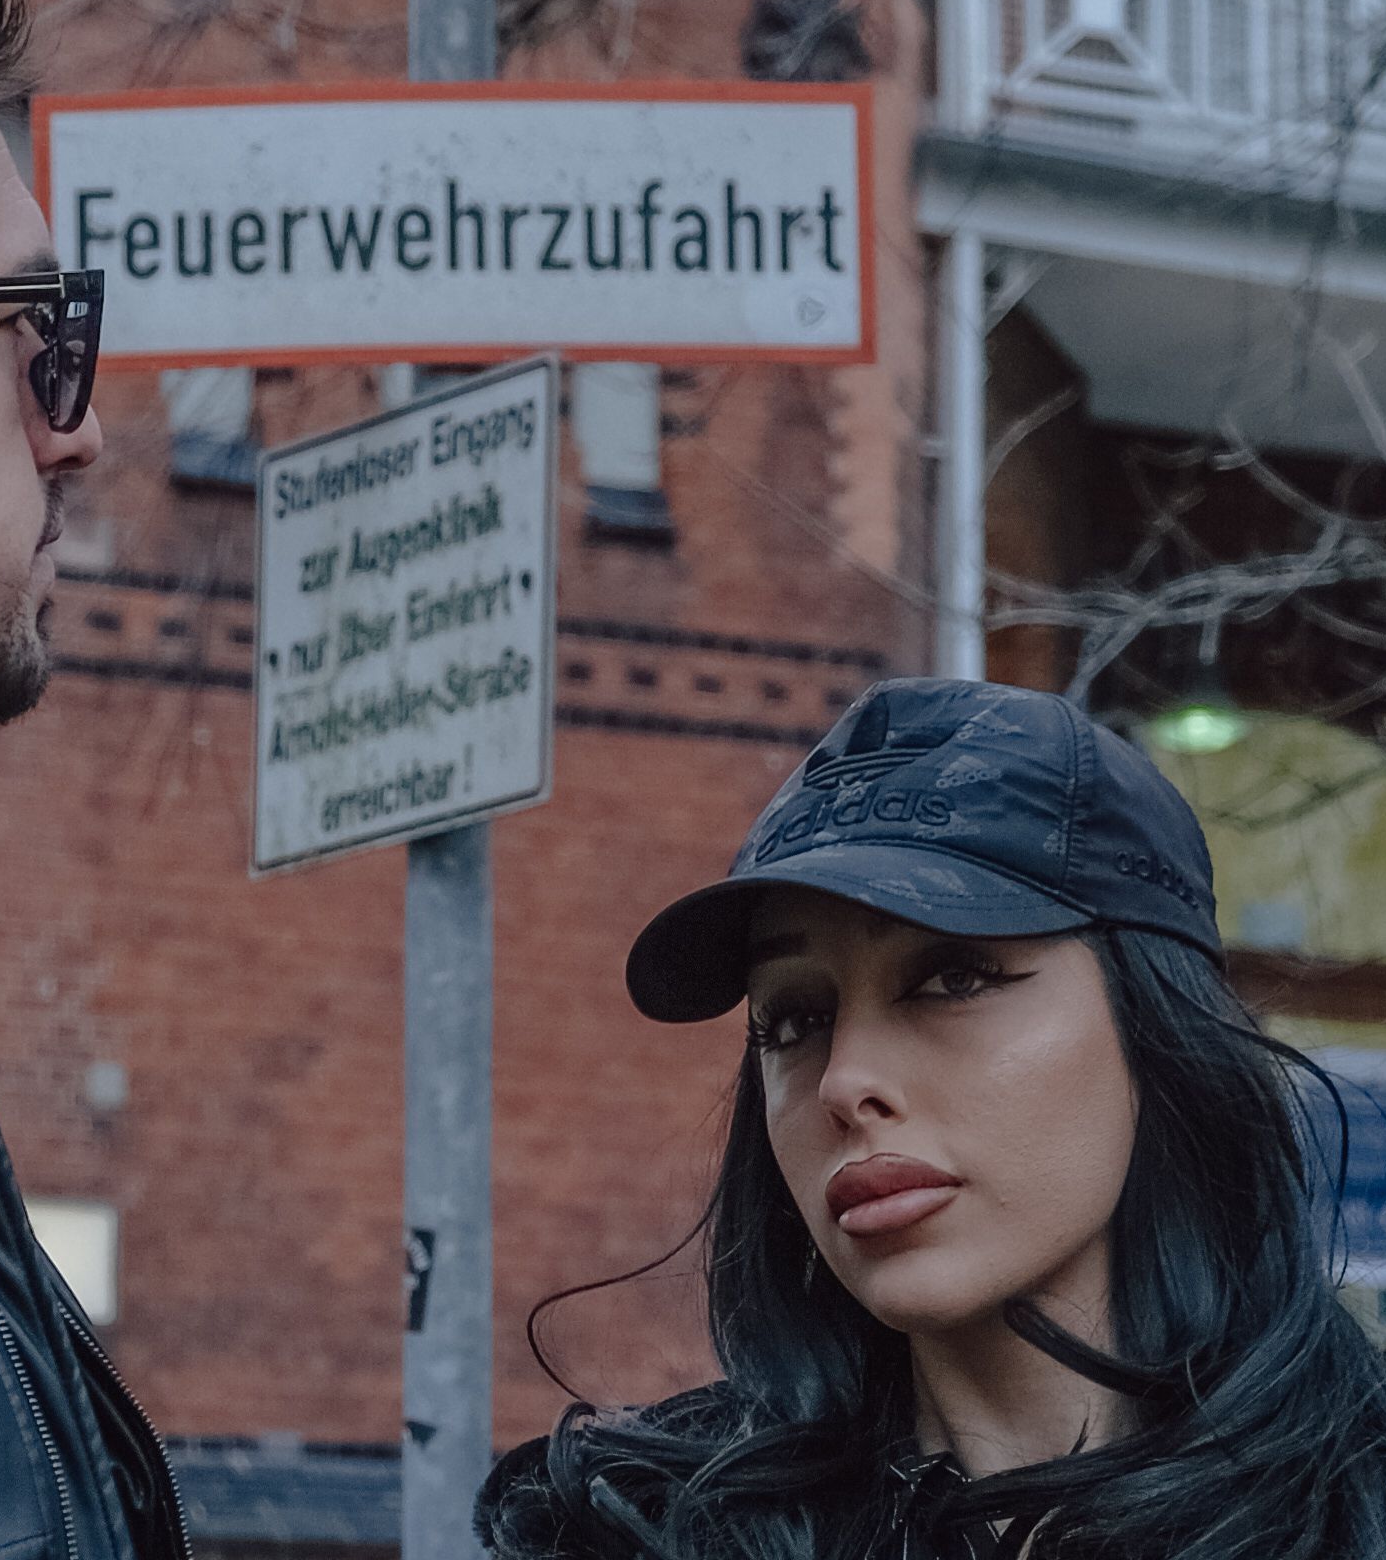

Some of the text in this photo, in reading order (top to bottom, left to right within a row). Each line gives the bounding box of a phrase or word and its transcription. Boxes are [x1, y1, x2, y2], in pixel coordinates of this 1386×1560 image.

[76, 181, 846, 278] Feuerwehrzufahrt
[275, 397, 535, 520] Stufenloser Eingang
[300, 483, 502, 593] zur Augenklinik
[289, 632, 329, 675] nur
[408, 562, 511, 642] Einfahrt
[322, 758, 454, 832] erreichbar
[755, 787, 956, 863] adidas
